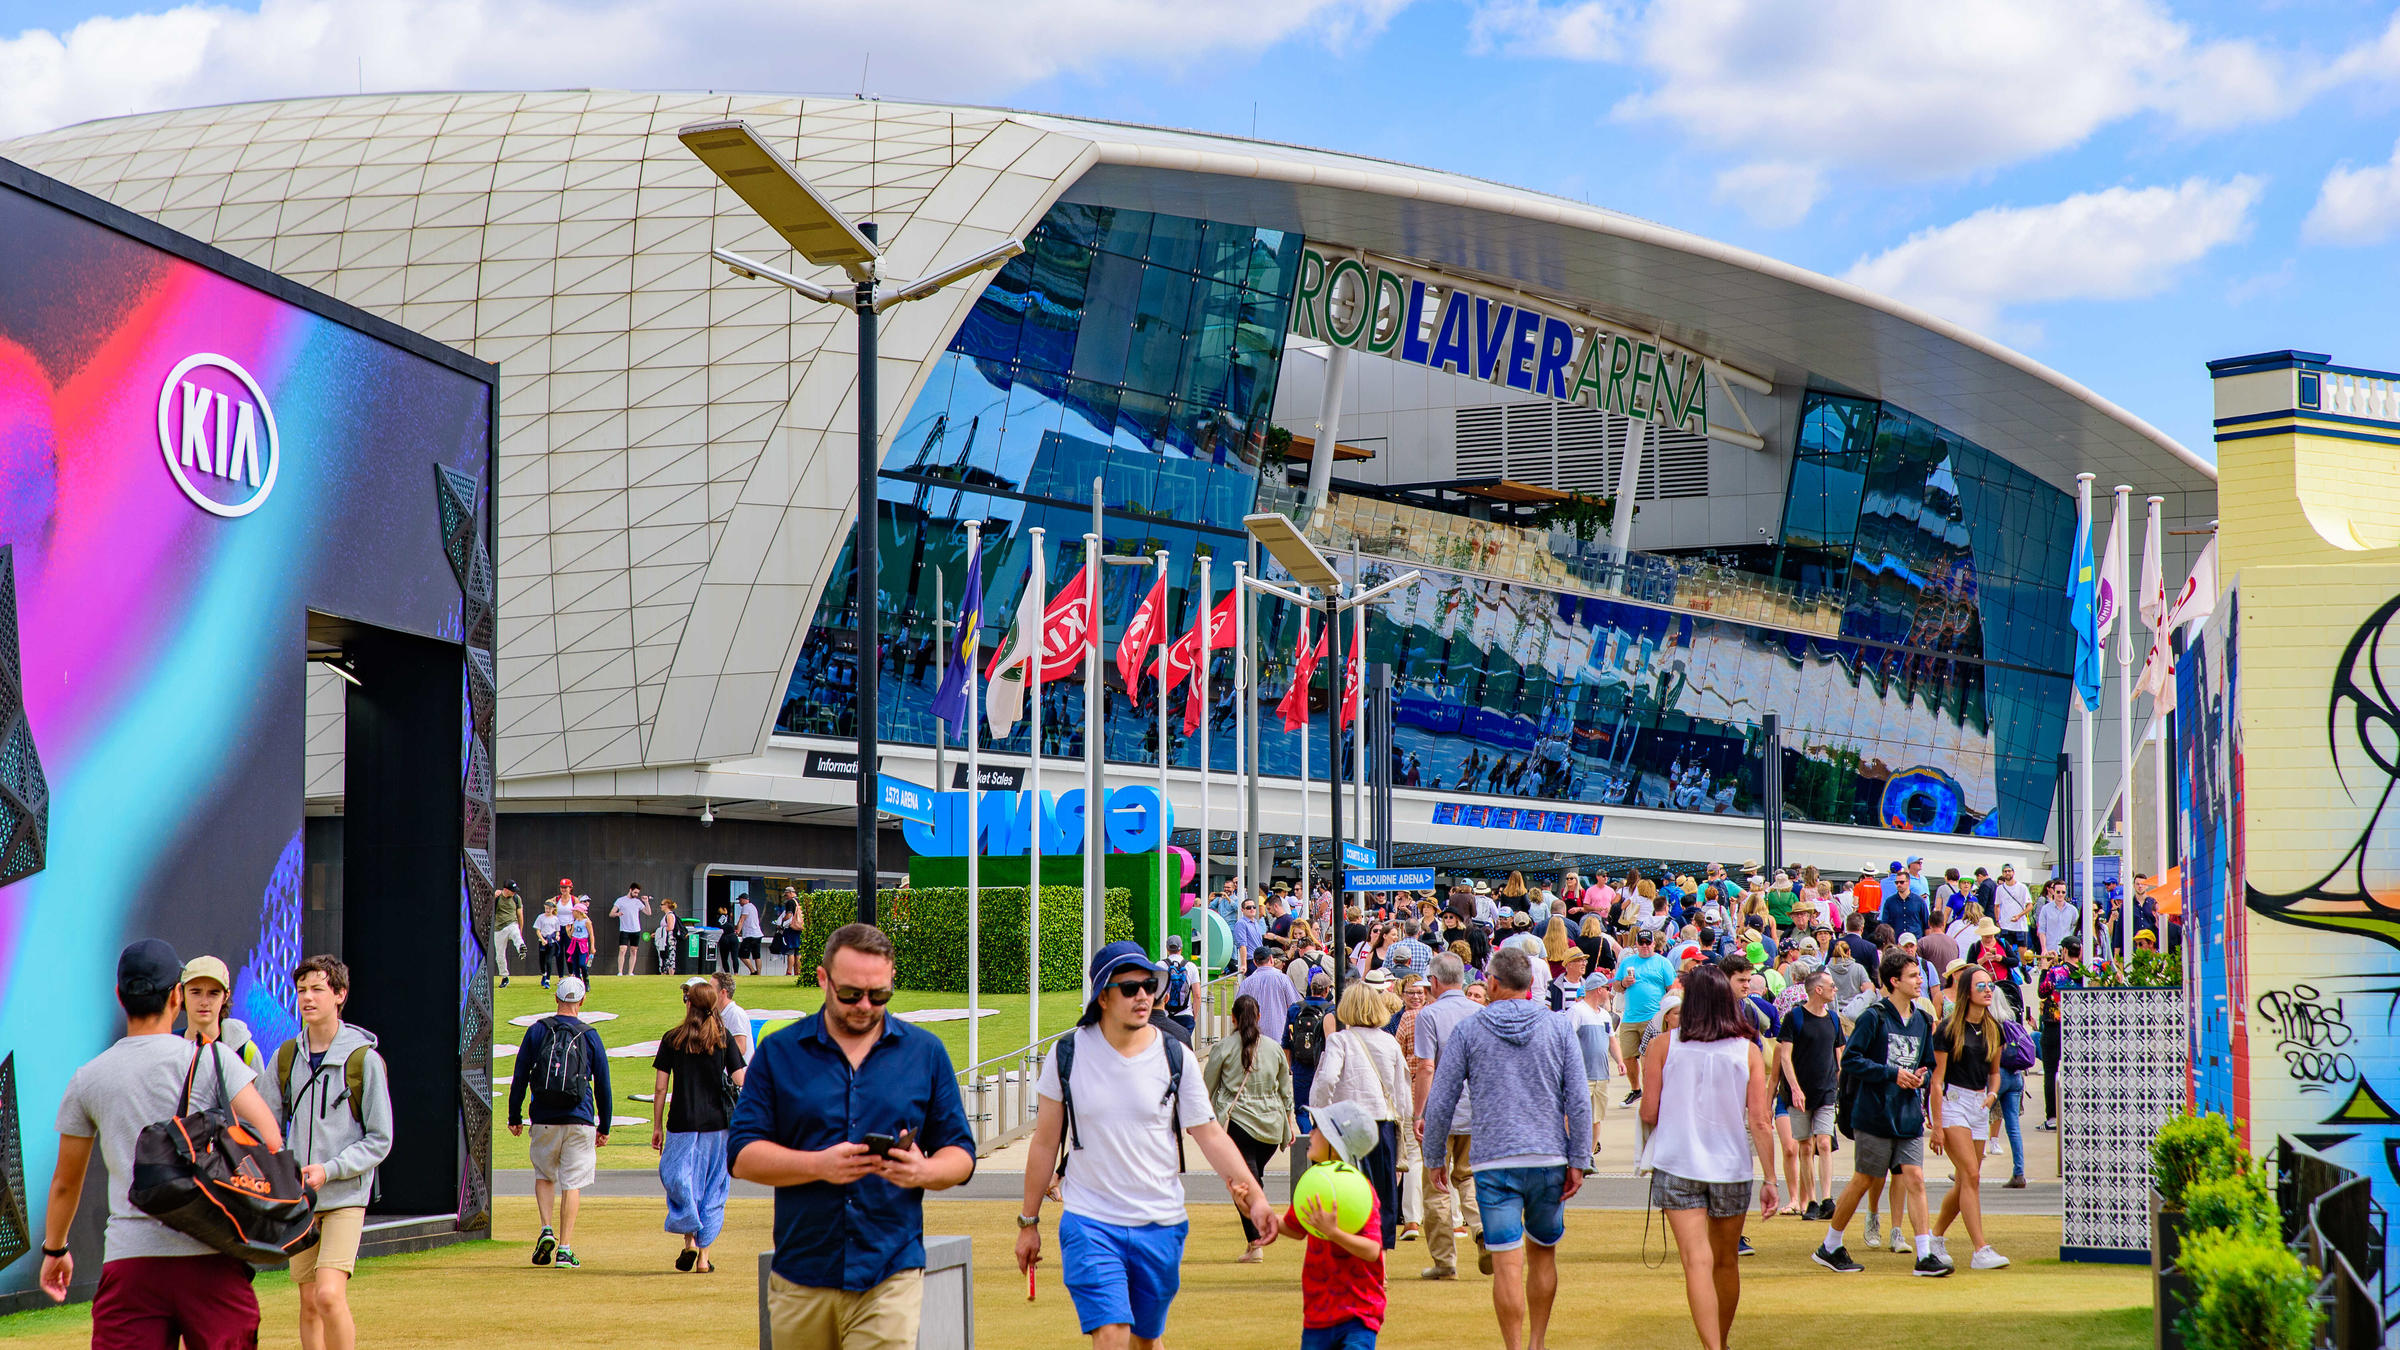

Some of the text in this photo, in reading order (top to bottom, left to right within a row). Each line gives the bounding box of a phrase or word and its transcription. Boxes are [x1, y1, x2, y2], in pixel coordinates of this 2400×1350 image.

[1292, 248, 1709, 437] ROD LAVER ARENA
[180, 380, 260, 488] KIA
[991, 771, 1014, 786] Sales
[885, 785, 919, 811] 1573 ARENA
[1351, 873, 1425, 885] MELBOURNE ARENA
[2285, 1051, 2356, 1083] 2020
